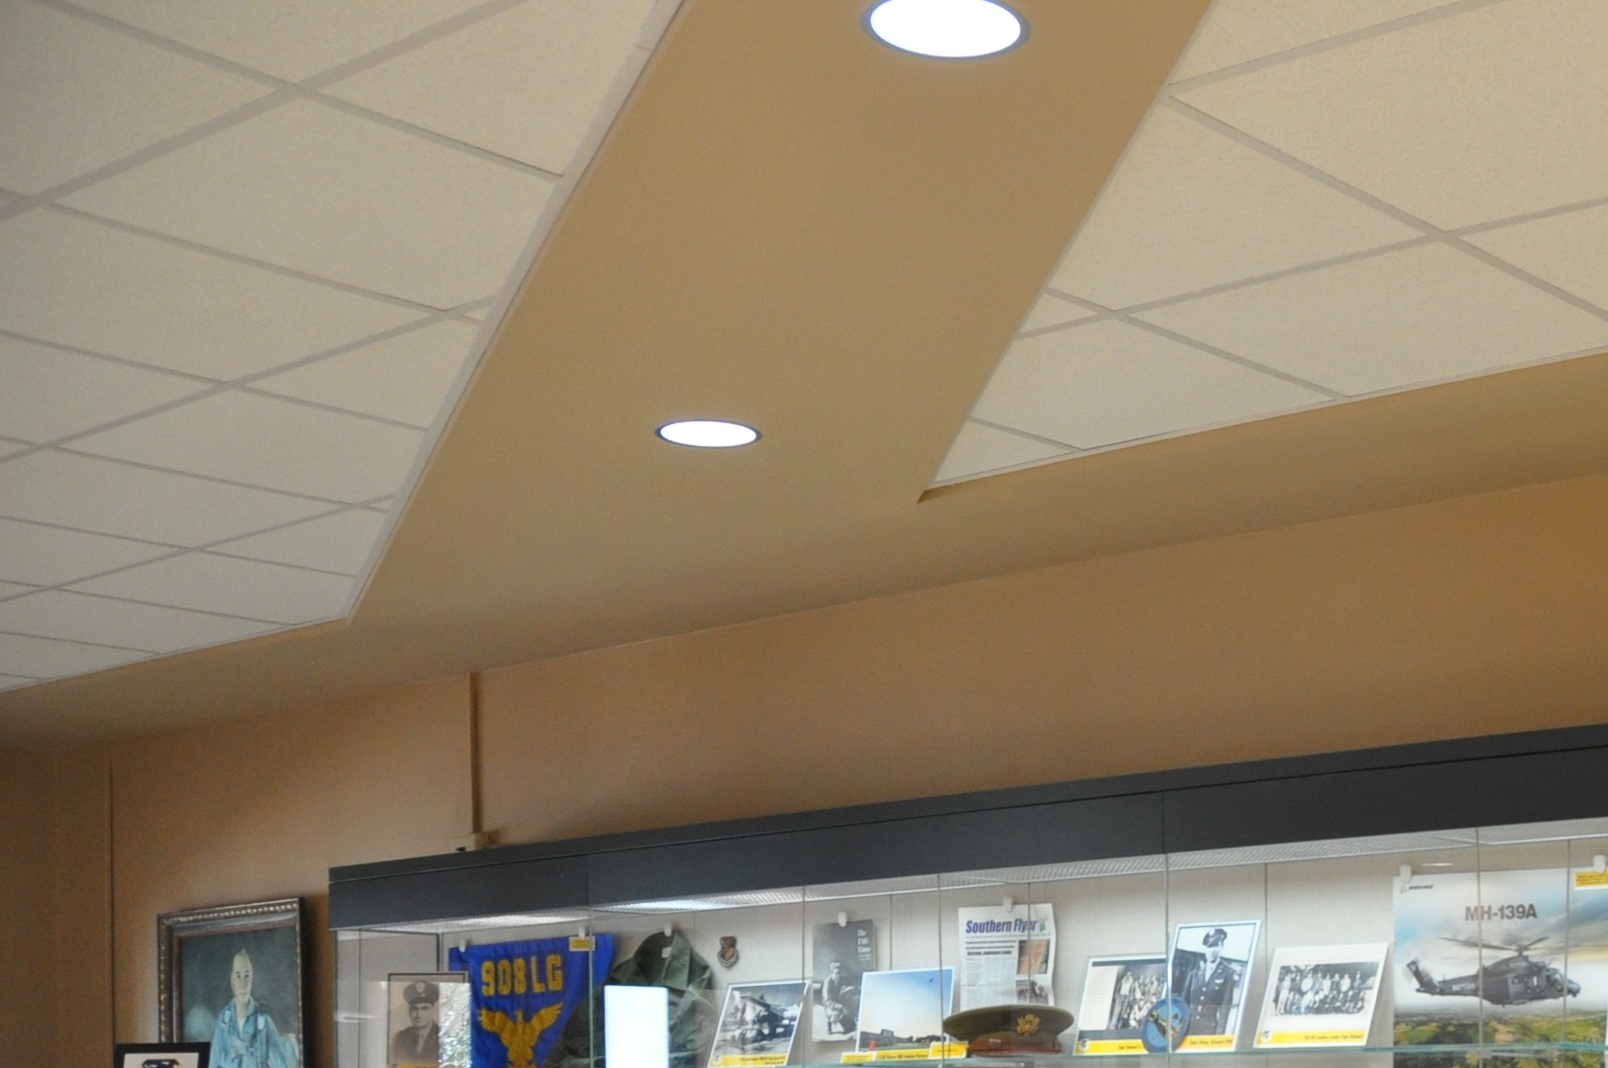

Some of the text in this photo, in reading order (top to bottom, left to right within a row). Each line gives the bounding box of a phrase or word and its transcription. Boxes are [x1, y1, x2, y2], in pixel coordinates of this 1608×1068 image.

[1465, 903, 1538, 922] MH-139A
[965, 917, 1038, 935] Southern Flyer
[481, 953, 564, 997] 908 LG
